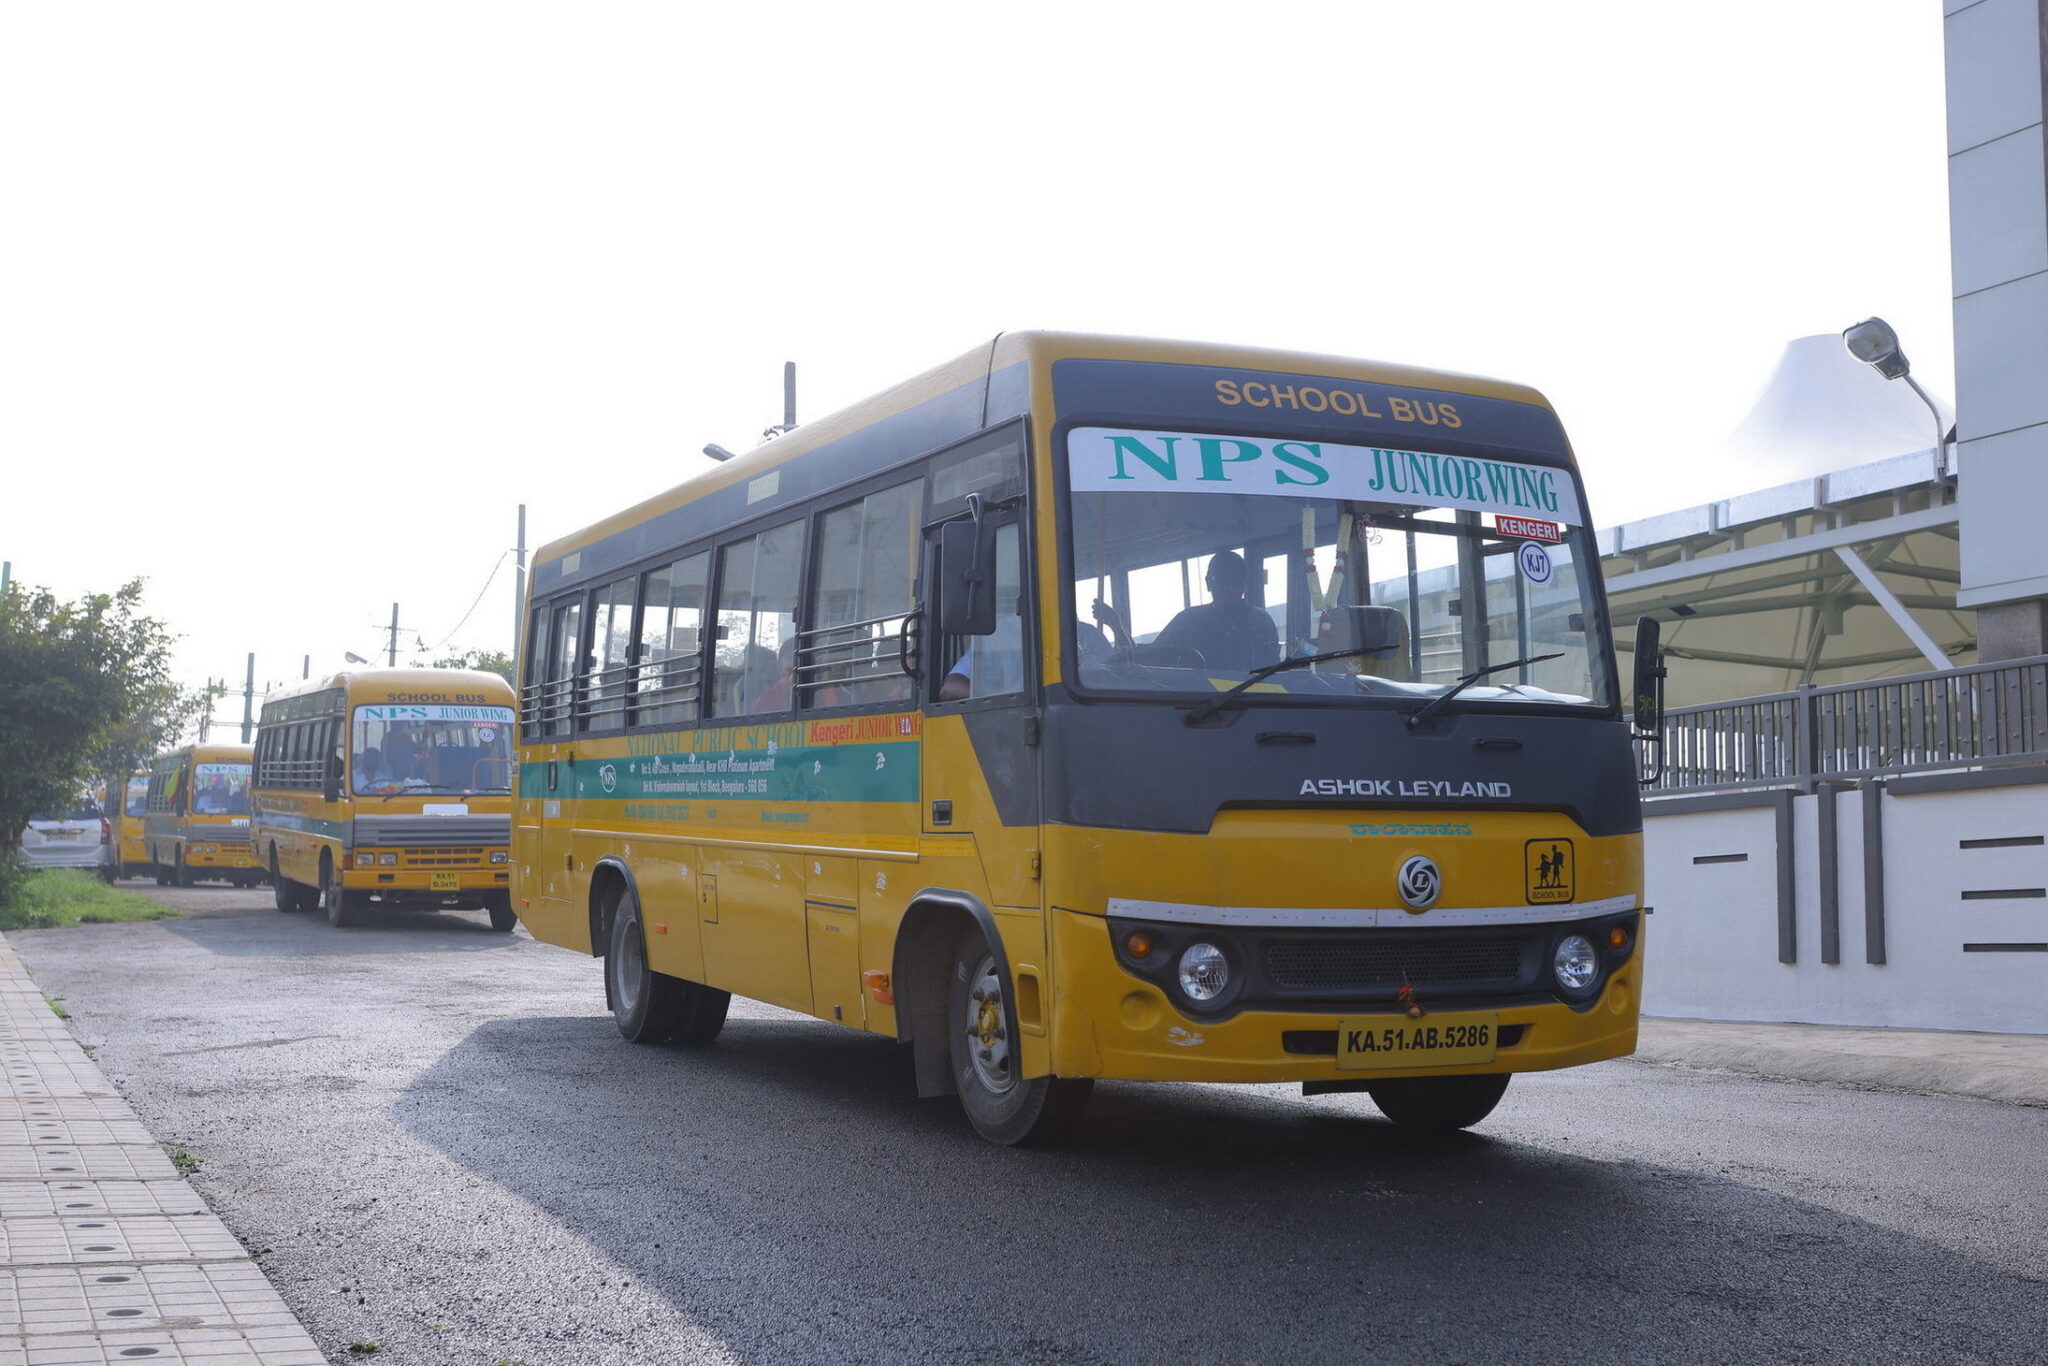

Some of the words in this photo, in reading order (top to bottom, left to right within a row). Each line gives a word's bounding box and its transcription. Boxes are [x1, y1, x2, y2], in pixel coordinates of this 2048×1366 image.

[1214, 379, 1382, 419] SCHOOL
[1388, 397, 1462, 429] BUS
[1103, 436, 1330, 486] NPS
[1499, 518, 1558, 540] KENGERI
[1526, 553, 1546, 573] KJ7
[386, 693, 451, 702] SCHOOL
[455, 694, 486, 703] BUS
[365, 707, 428, 719] NPS
[439, 706, 479, 720] JUNIOR
[480, 707, 508, 721] WING
[691, 726, 742, 754] PUBLIC
[748, 721, 806, 750] SCHOOL
[810, 718, 854, 746] Kengeri
[855, 715, 892, 740] JUNIOR
[1299, 779, 1394, 796] ASHOK
[1399, 780, 1512, 798] LEYLAND
[1532, 891, 1556, 900] SCHOOL
[1557, 890, 1569, 899] BUS
[1347, 1024, 1489, 1053] KA.51.AB.5286
